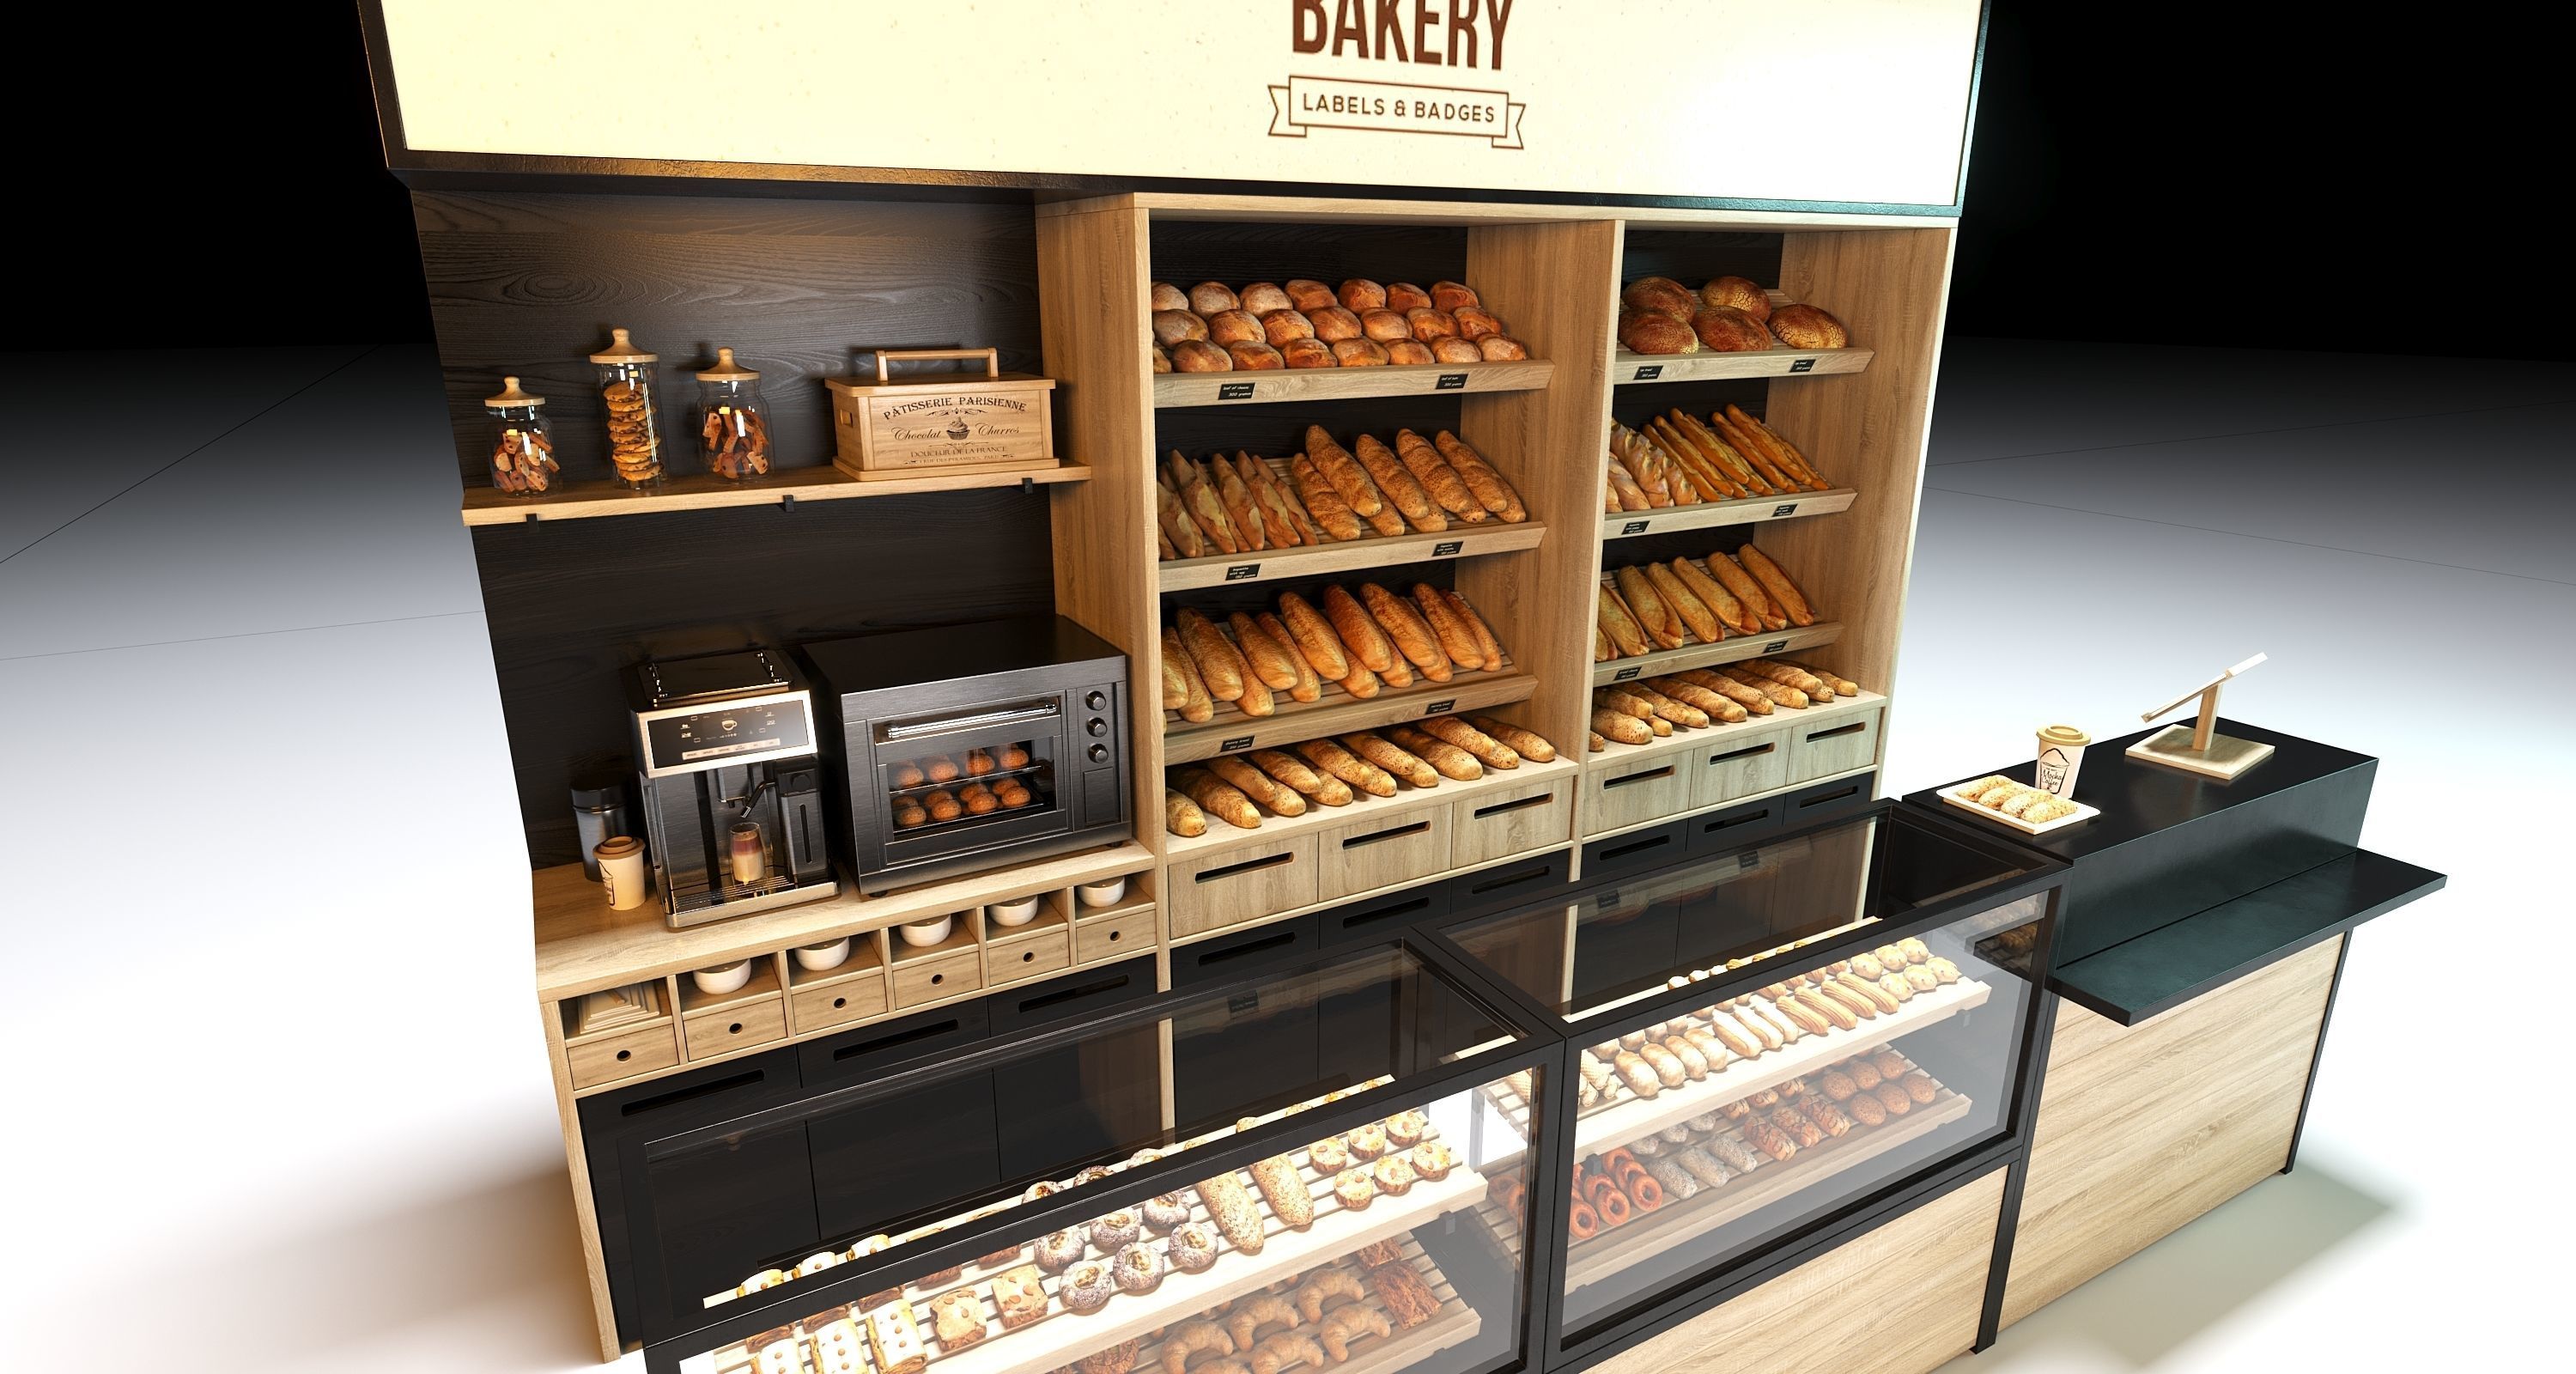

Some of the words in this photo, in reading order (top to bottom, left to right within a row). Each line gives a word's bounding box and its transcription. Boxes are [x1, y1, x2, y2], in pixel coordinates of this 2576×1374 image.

[1292, 0, 1514, 71] BAKERY
[1303, 93, 1385, 117] LABELS
[1394, 100, 1406, 117] &
[1414, 100, 1495, 123] BADGES
[883, 397, 952, 420] PÂTISSERIE
[959, 396, 1027, 412] PARISIENNE
[890, 426, 941, 441] Chocolat
[975, 422, 1019, 435] Churros
